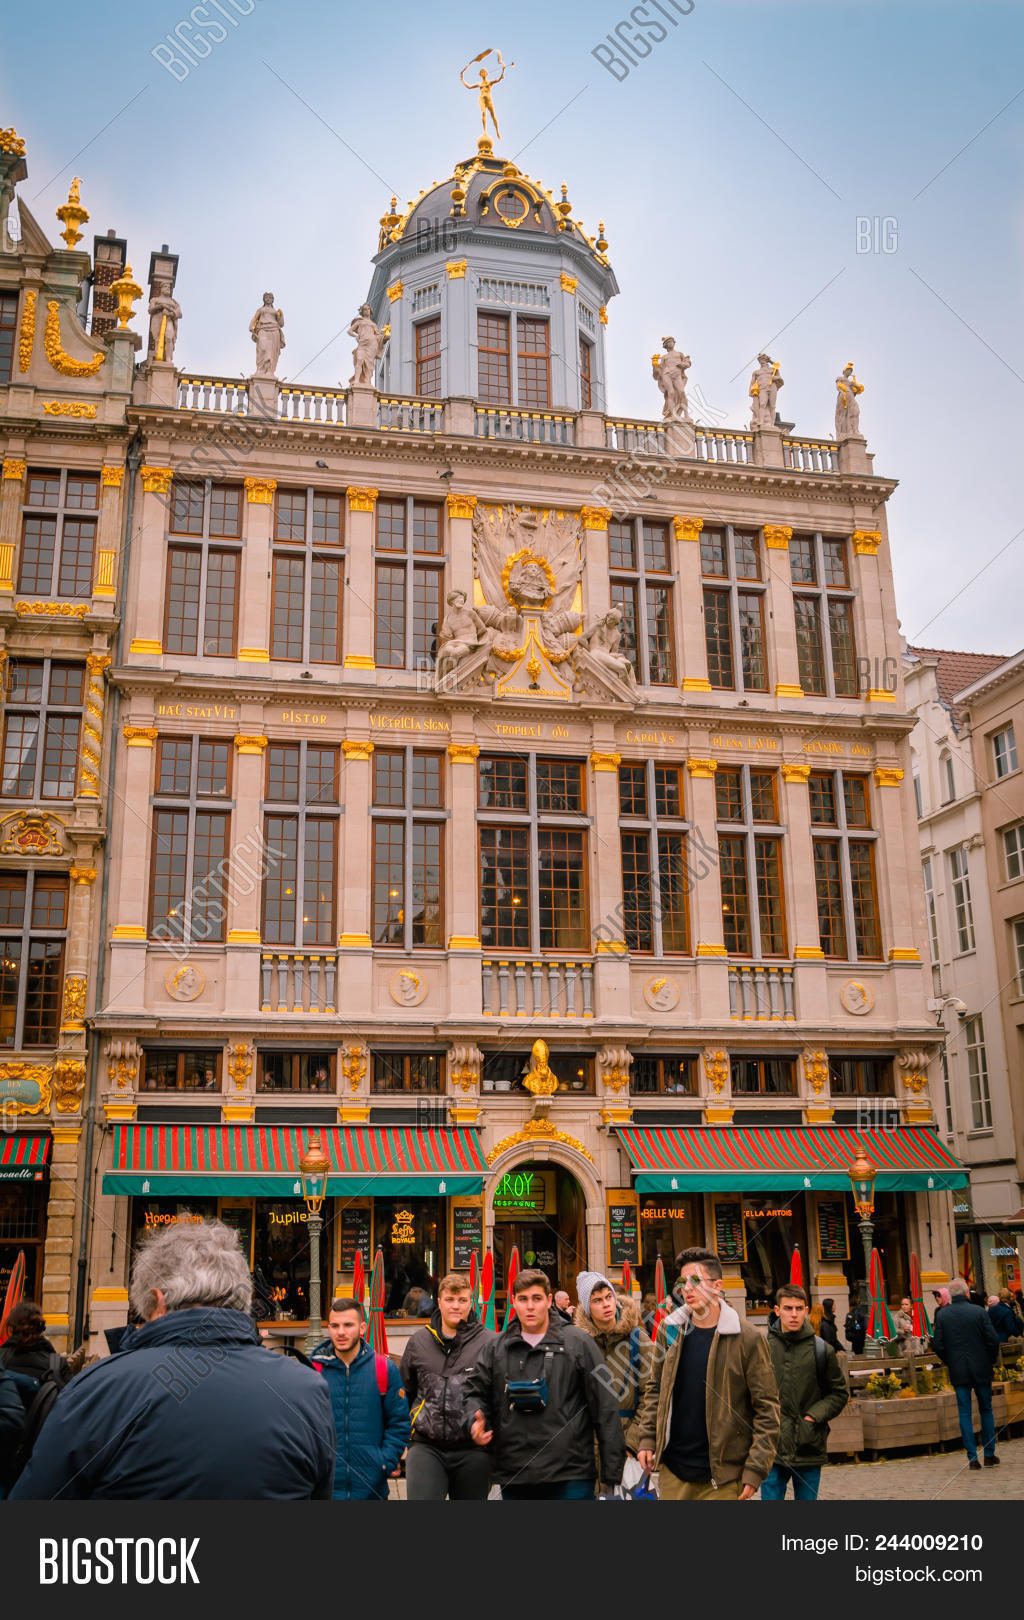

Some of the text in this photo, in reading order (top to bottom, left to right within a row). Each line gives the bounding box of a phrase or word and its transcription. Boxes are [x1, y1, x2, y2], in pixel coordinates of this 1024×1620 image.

[643, 1208, 685, 1219] BELLE VUE
[766, 1209, 793, 1217] ARTOIS
